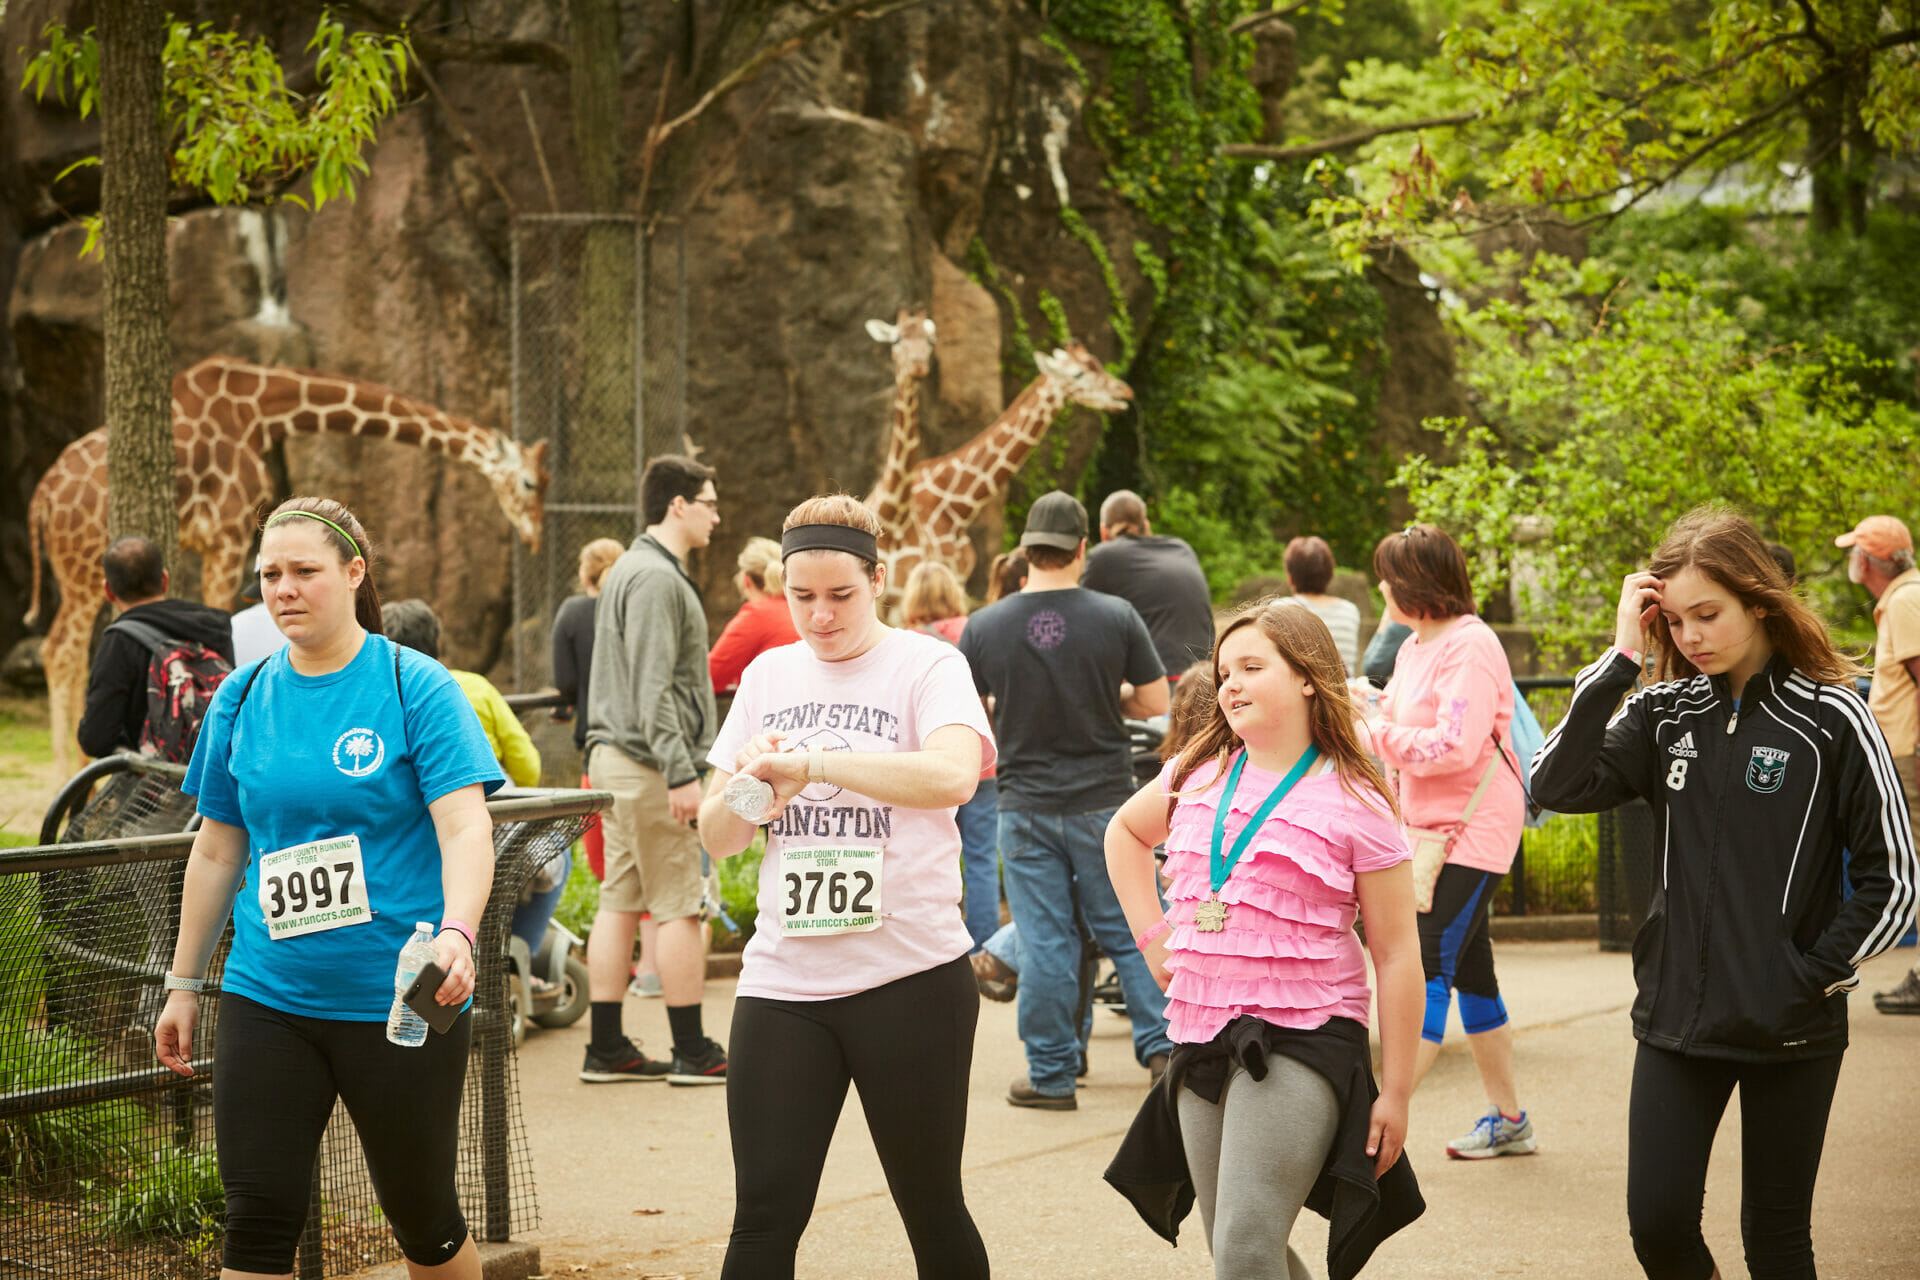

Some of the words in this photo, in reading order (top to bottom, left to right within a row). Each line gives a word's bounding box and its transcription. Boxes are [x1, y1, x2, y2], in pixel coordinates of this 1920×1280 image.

[762, 701, 825, 731] PENN
[825, 703, 899, 744] STATE
[1667, 746, 1698, 758] adidas
[1666, 758, 1688, 791] 8
[267, 852, 292, 865] CHESTER
[293, 846, 318, 858] COUNTY
[319, 840, 352, 853] RUNNING
[296, 854, 318, 866] STORE
[786, 850, 812, 860] CHESTER
[813, 849, 841, 859] COUNTY
[843, 849, 875, 859] RUNNING
[816, 858, 838, 867] STORE
[267, 862, 354, 918] 3997
[785, 870, 874, 916] 3762
[274, 906, 362, 931] www.runccrs.com
[786, 915, 874, 929] www.runccrs.com
